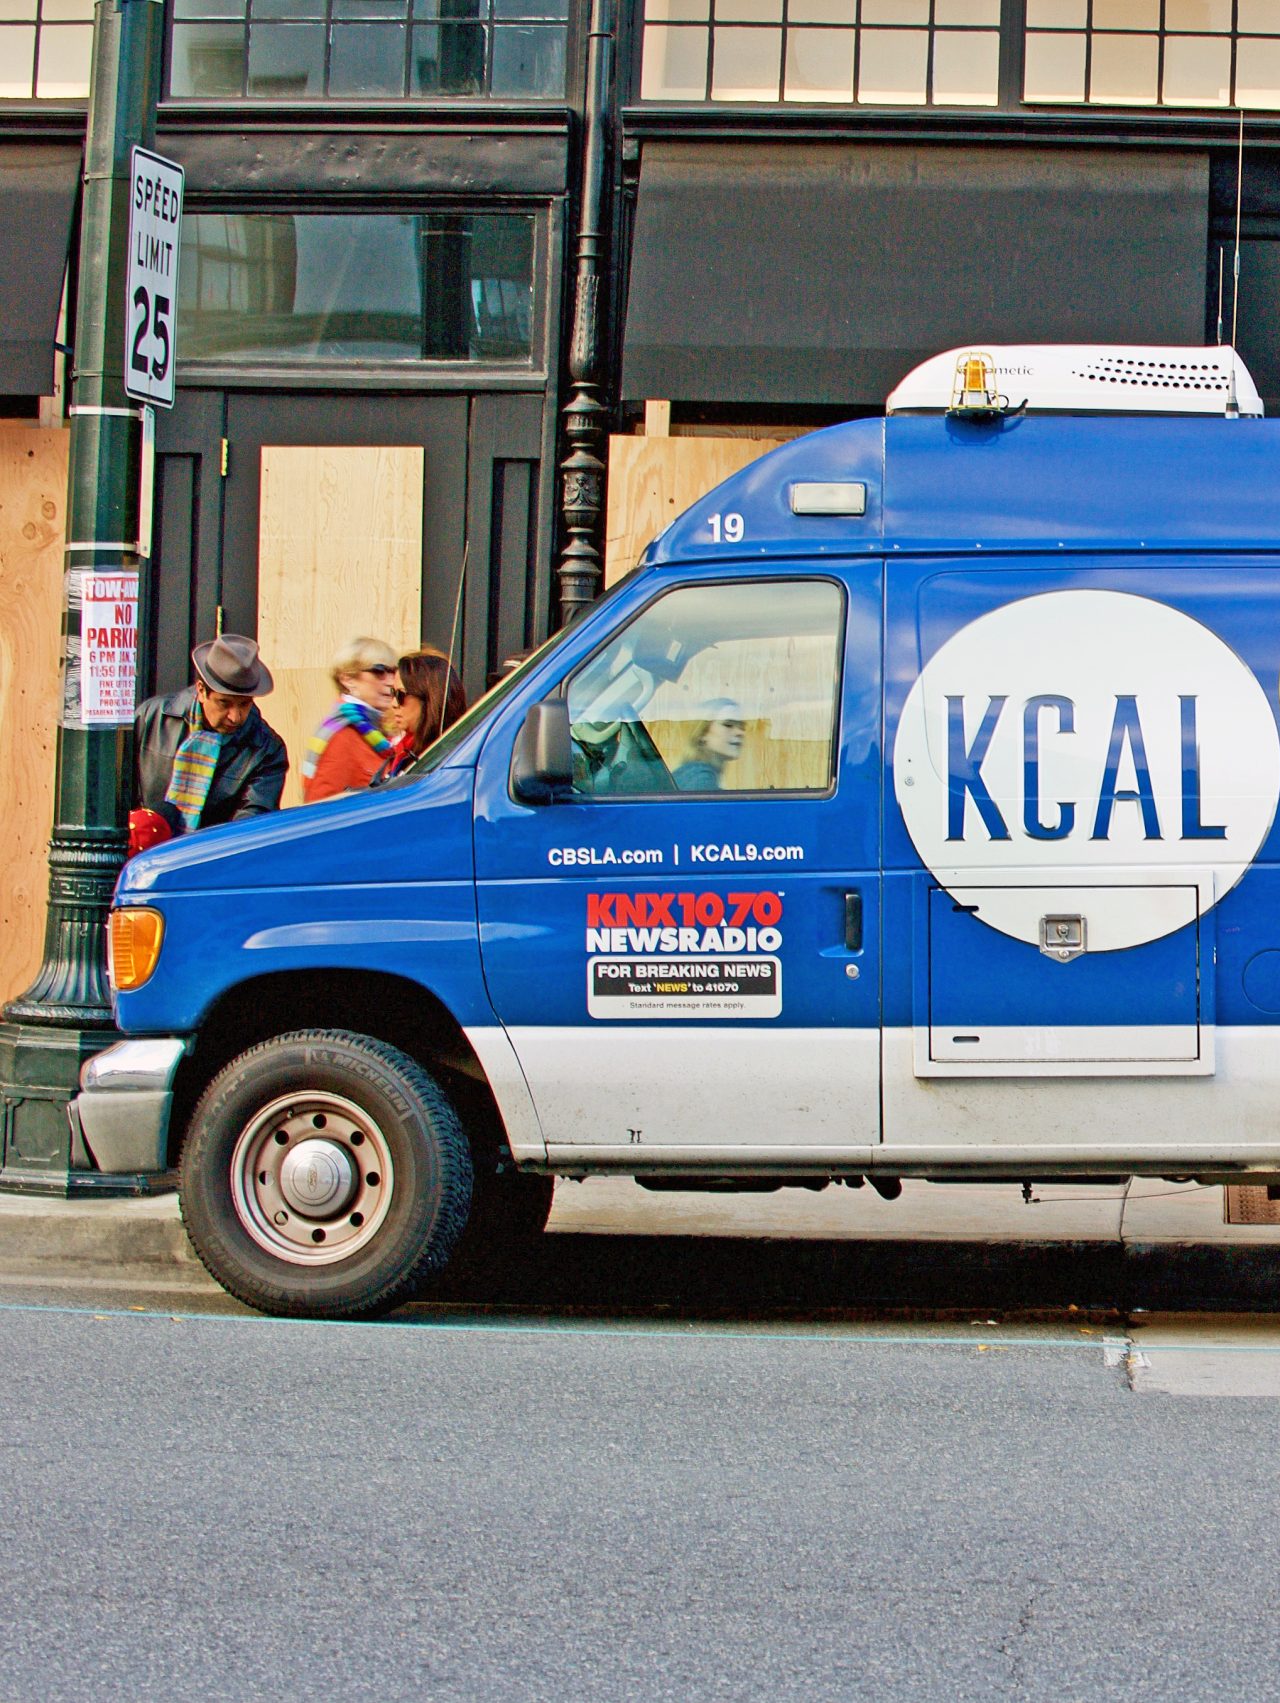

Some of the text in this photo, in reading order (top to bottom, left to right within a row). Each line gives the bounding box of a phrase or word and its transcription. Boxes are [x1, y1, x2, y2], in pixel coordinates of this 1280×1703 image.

[135, 175, 179, 224] SPEED
[137, 231, 173, 277] LIMIT
[131, 285, 170, 382] 25
[707, 512, 745, 543] 19
[114, 603, 132, 625] NO
[90, 651, 96, 663] 6
[100, 650, 115, 663] PM
[90, 665, 115, 677] 11:59
[944, 693, 1228, 842] KCAL
[548, 847, 663, 866] CBSLA.com
[690, 844, 804, 862] KCAL9.com
[586, 925, 783, 953] NEWSRADIO
[597, 963, 772, 978] FOR BREAKING NEWS
[628, 982, 652, 993] Text
[692, 982, 704, 993] to
[705, 982, 739, 993] 41070
[629, 1001, 747, 1011] Standard message rates apply.
[332, 1053, 412, 1114] MICHELIN
